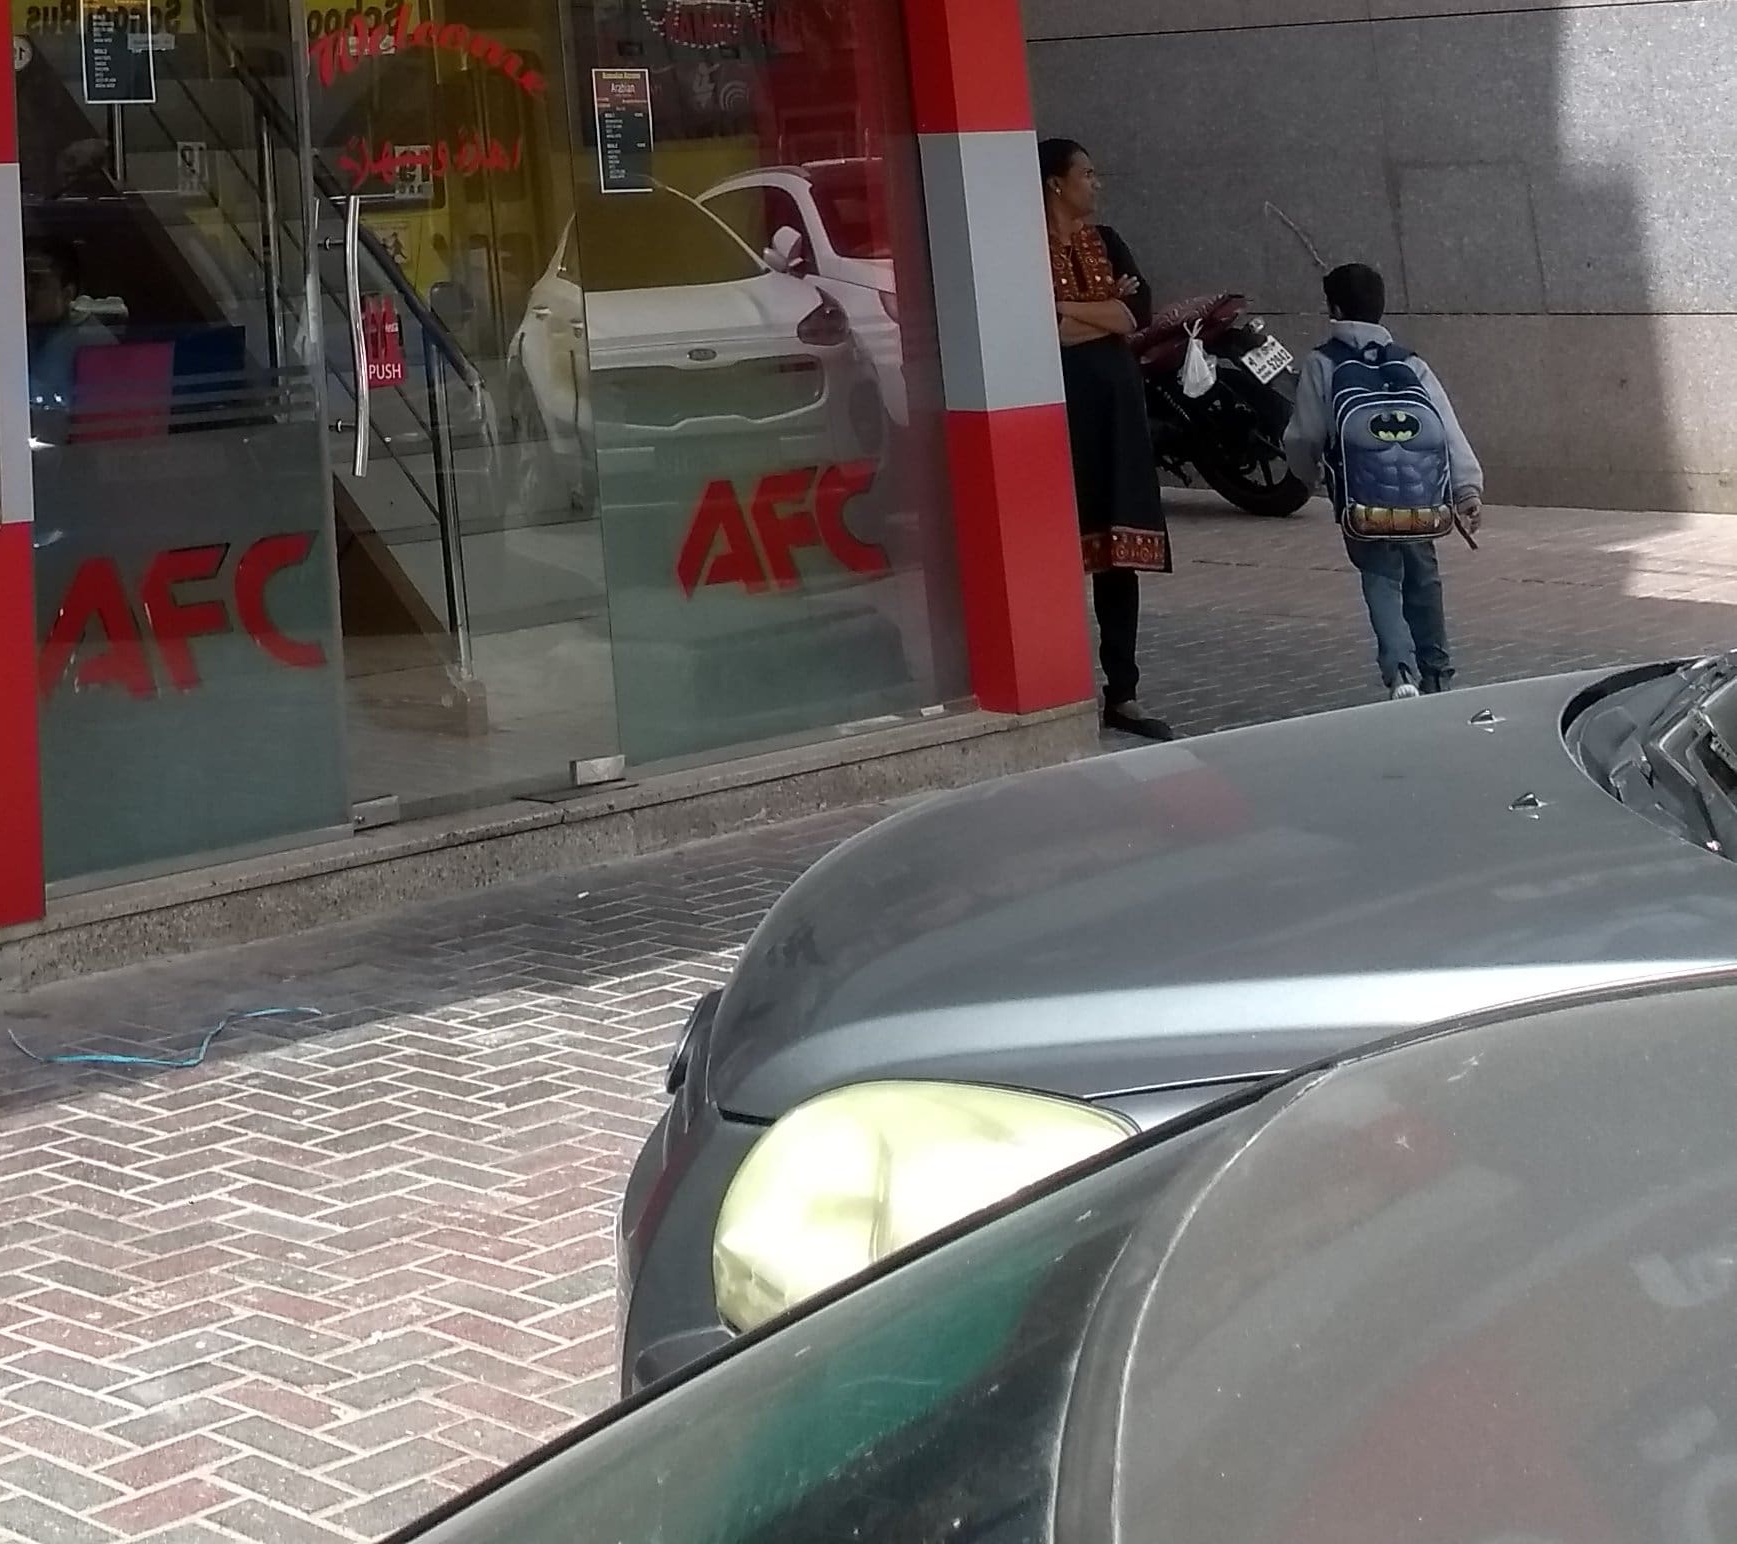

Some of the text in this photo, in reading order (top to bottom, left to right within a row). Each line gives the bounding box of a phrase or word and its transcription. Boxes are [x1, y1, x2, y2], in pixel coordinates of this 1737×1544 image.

[368, 363, 402, 381] PUSH
[674, 457, 893, 602] AFC
[36, 530, 329, 704] AFC
